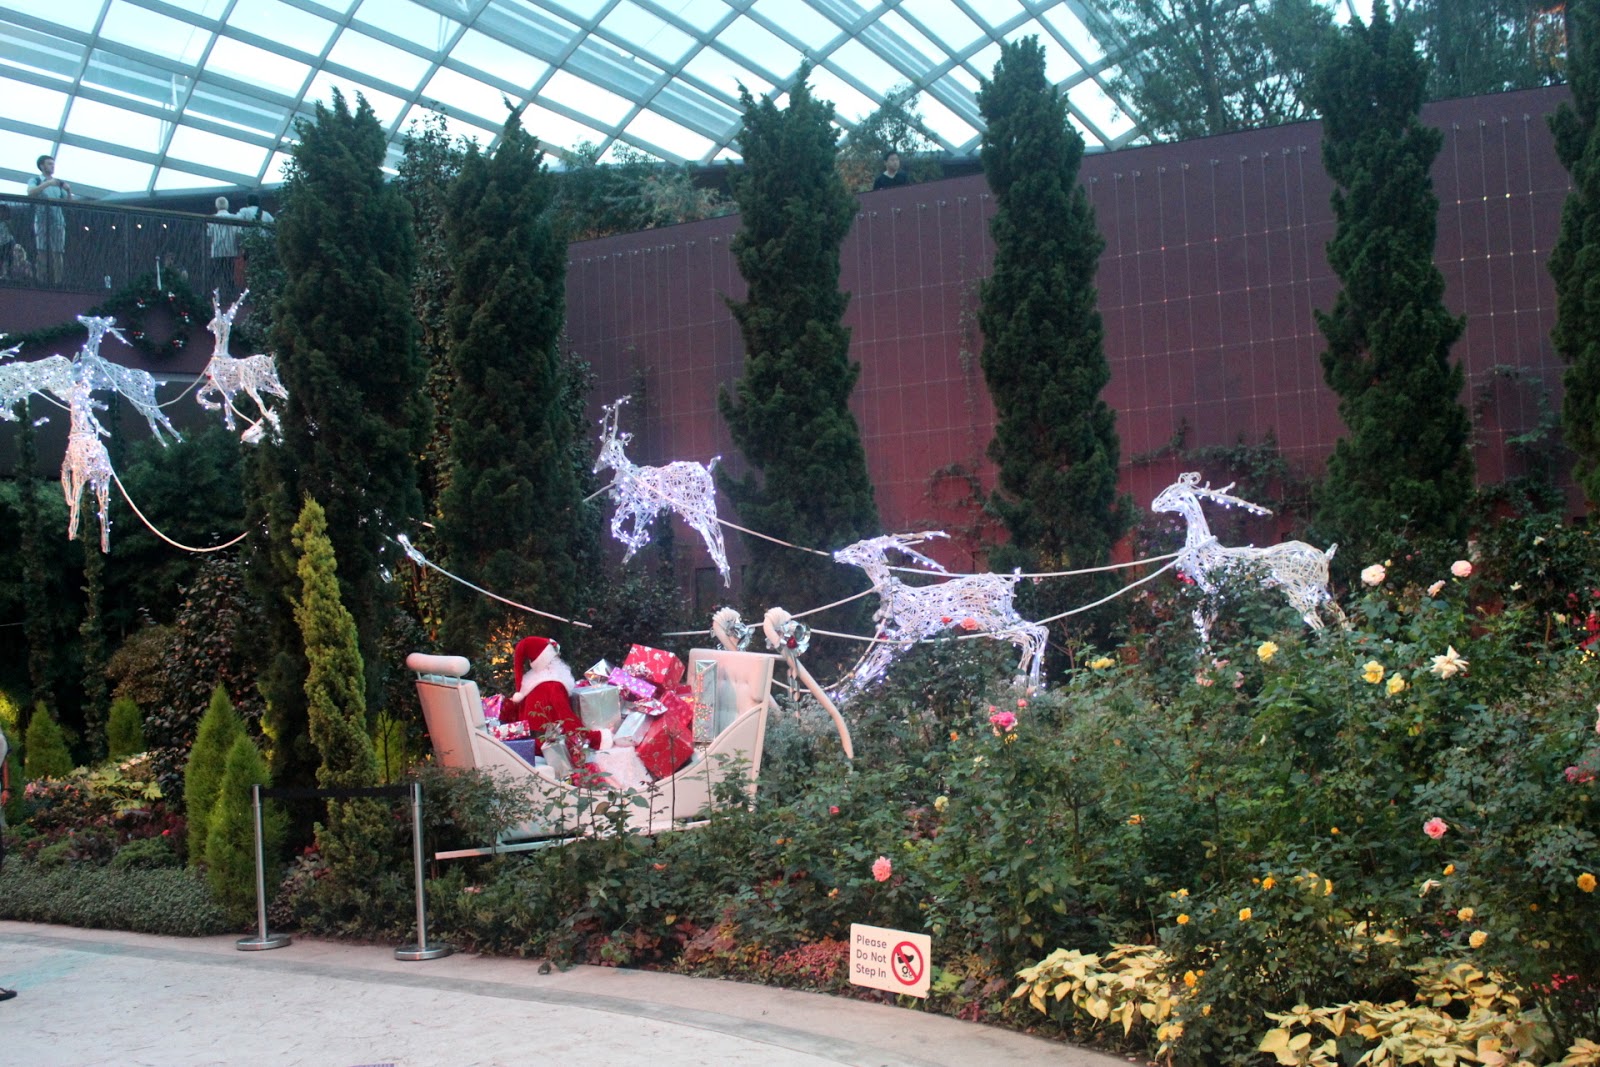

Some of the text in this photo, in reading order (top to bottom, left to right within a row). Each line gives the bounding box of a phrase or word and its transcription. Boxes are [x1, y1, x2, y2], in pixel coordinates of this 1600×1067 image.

[857, 935, 887, 949] Please
[856, 949, 887, 963] Do Not
[856, 964, 887, 978] Step In
